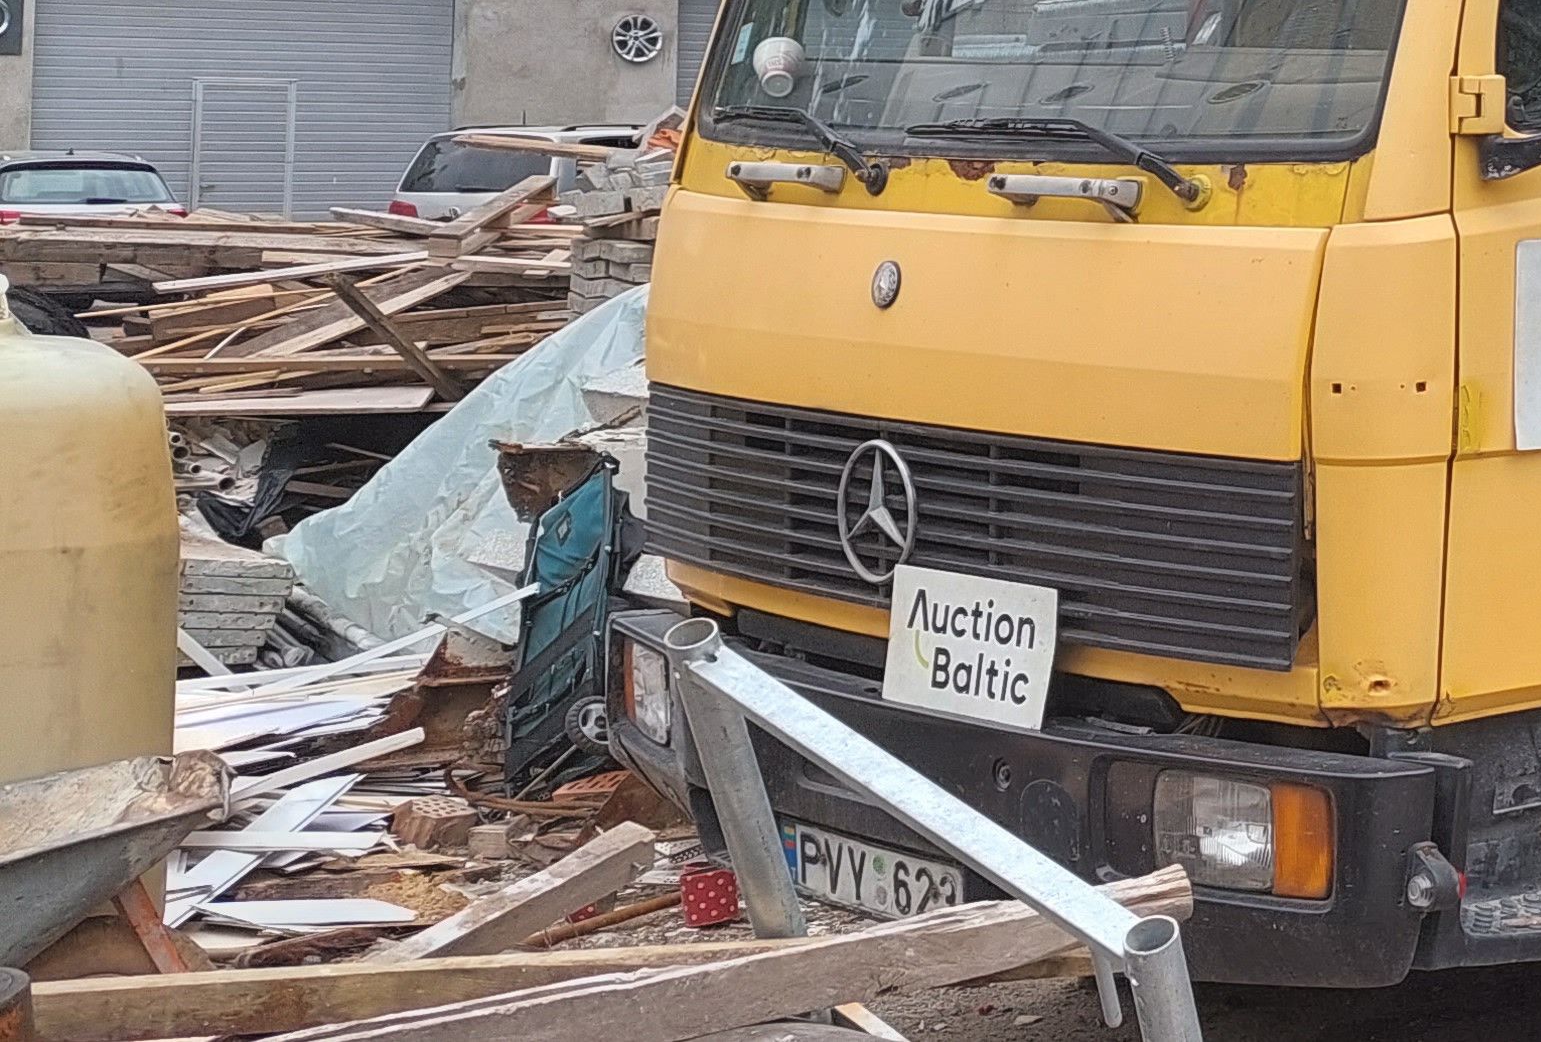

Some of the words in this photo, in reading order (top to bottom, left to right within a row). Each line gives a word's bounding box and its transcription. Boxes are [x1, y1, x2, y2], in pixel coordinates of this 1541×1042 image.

[906, 588, 1036, 650] Auction
[930, 646, 1030, 705] Baltic
[799, 831, 867, 901] PVY
